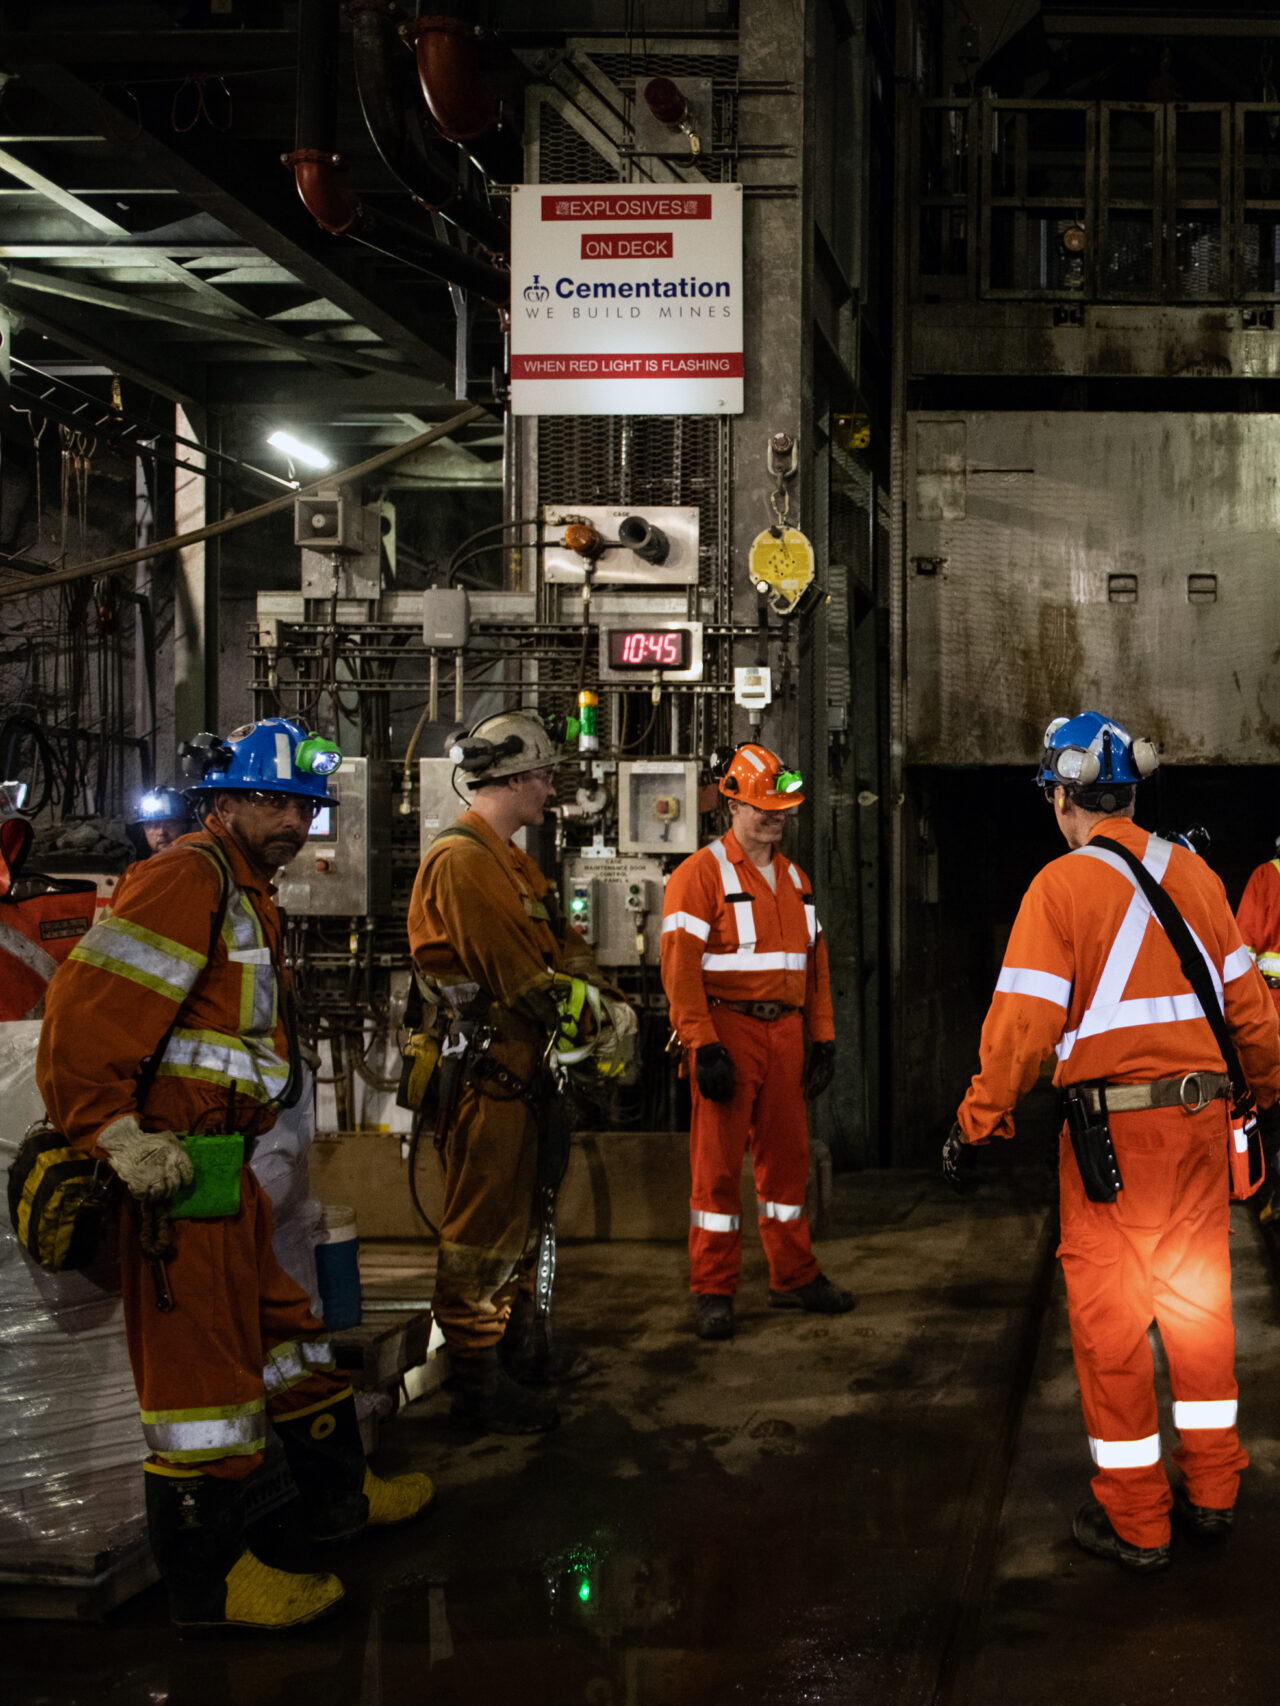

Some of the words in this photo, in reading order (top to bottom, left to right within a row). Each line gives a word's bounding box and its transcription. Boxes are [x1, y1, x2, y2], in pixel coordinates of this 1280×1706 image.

[570, 200, 683, 216] EXPLOSIVES
[586, 241, 612, 257] ON
[618, 240, 668, 256] DECK
[555, 277, 731, 299] Cementation
[525, 306, 554, 319] WE
[572, 306, 641, 319] BUILD
[659, 305, 732, 318] MINES
[523, 360, 566, 373] WHEN
[569, 360, 598, 373] RED
[601, 359, 642, 372] LIGHT
[645, 359, 659, 372] IS
[662, 358, 730, 372] FLASHING
[621, 633, 679, 664] 10:45
